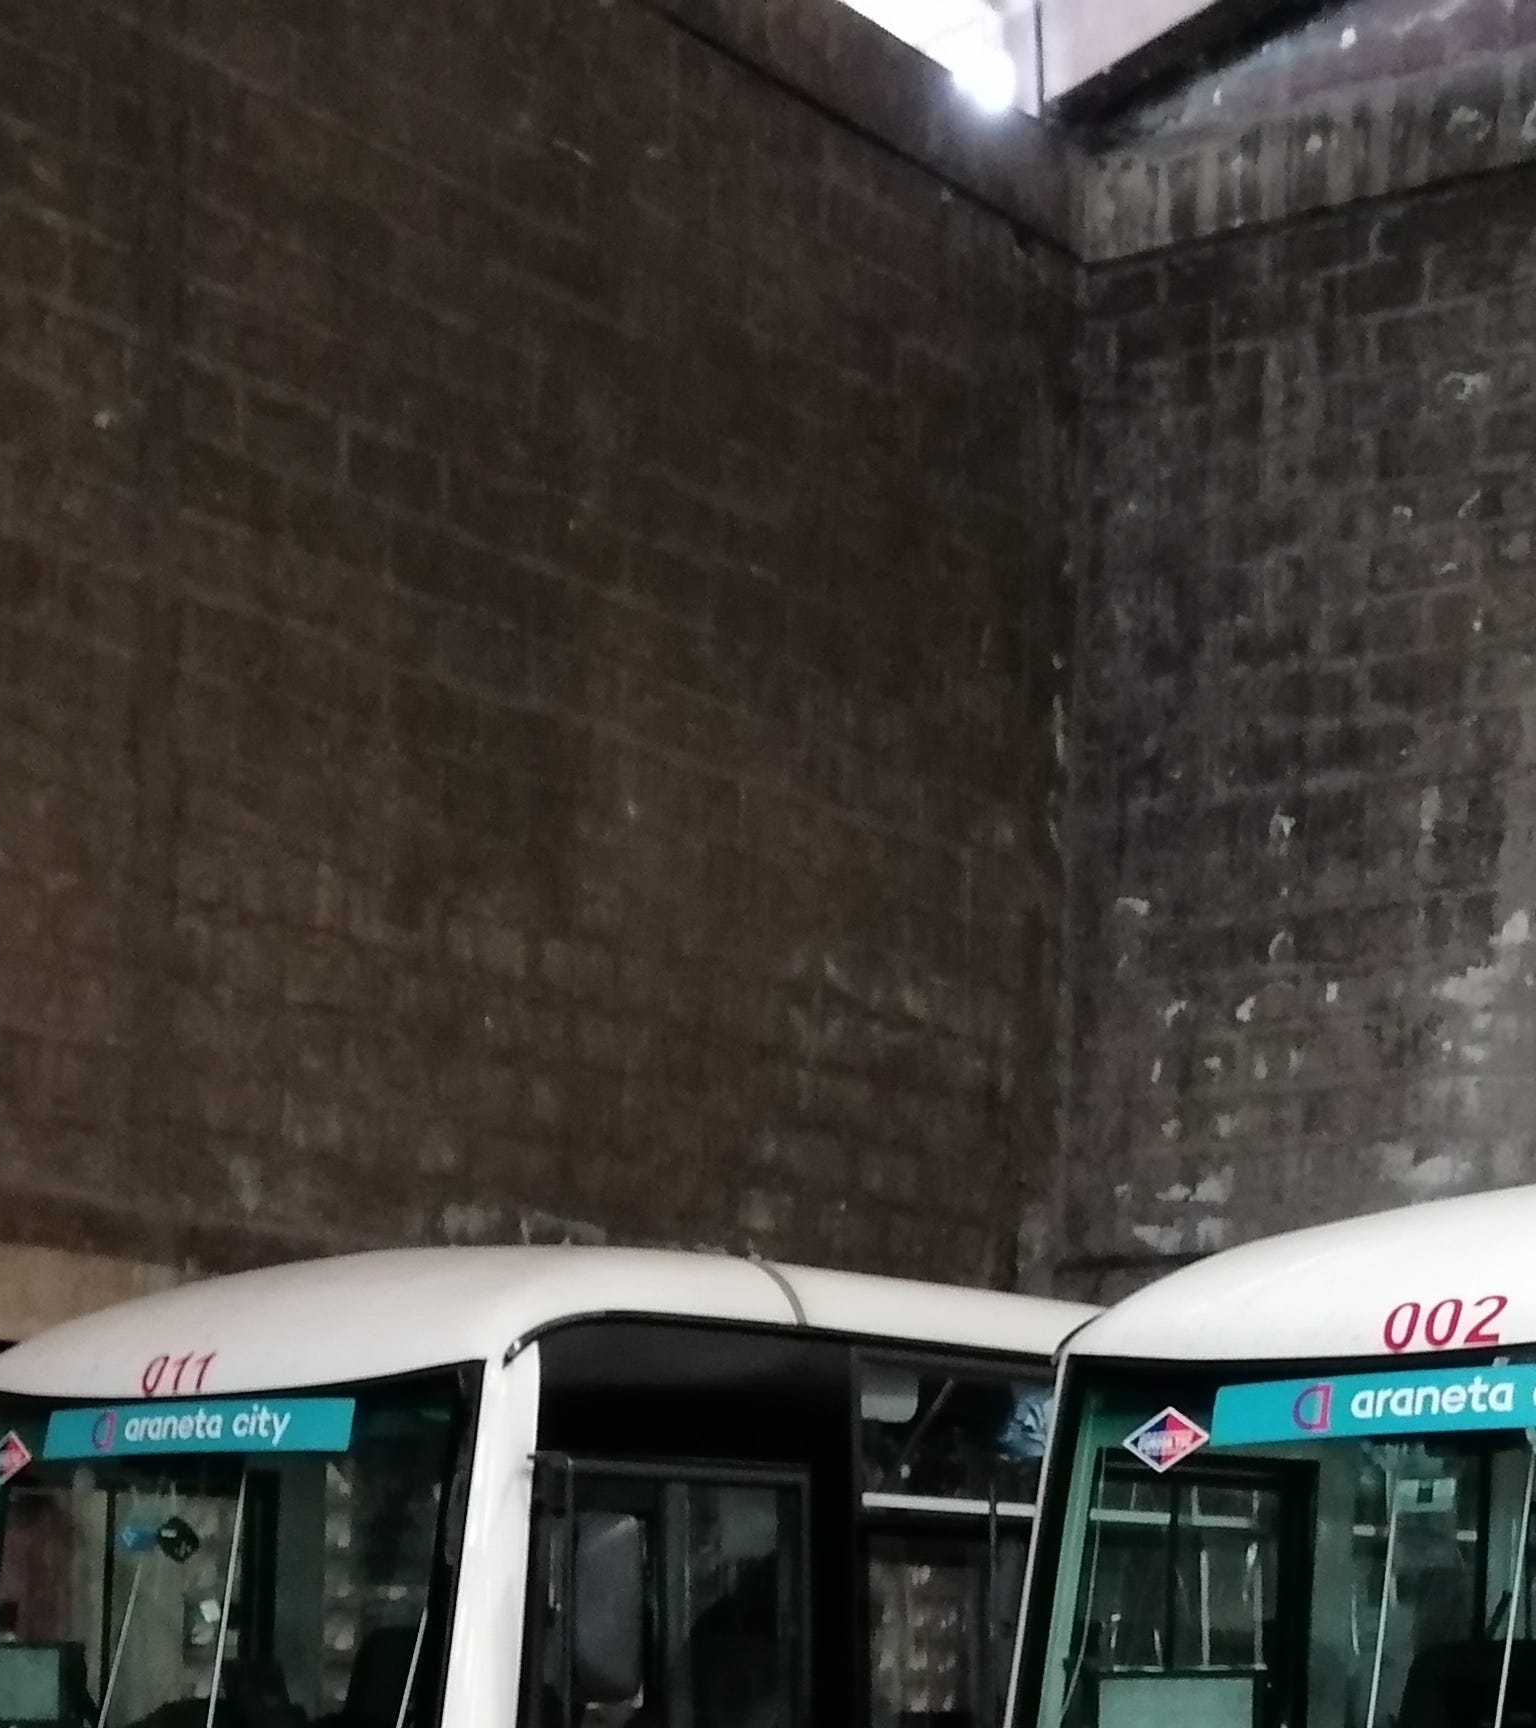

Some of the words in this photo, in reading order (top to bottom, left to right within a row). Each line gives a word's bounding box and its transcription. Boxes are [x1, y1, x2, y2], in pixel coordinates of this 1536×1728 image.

[1384, 1296, 1507, 1351] 002
[142, 1350, 216, 1397] 011
[1351, 1380, 1514, 1419] araneta
[124, 1413, 222, 1442] araneta
[232, 1403, 291, 1448] city
